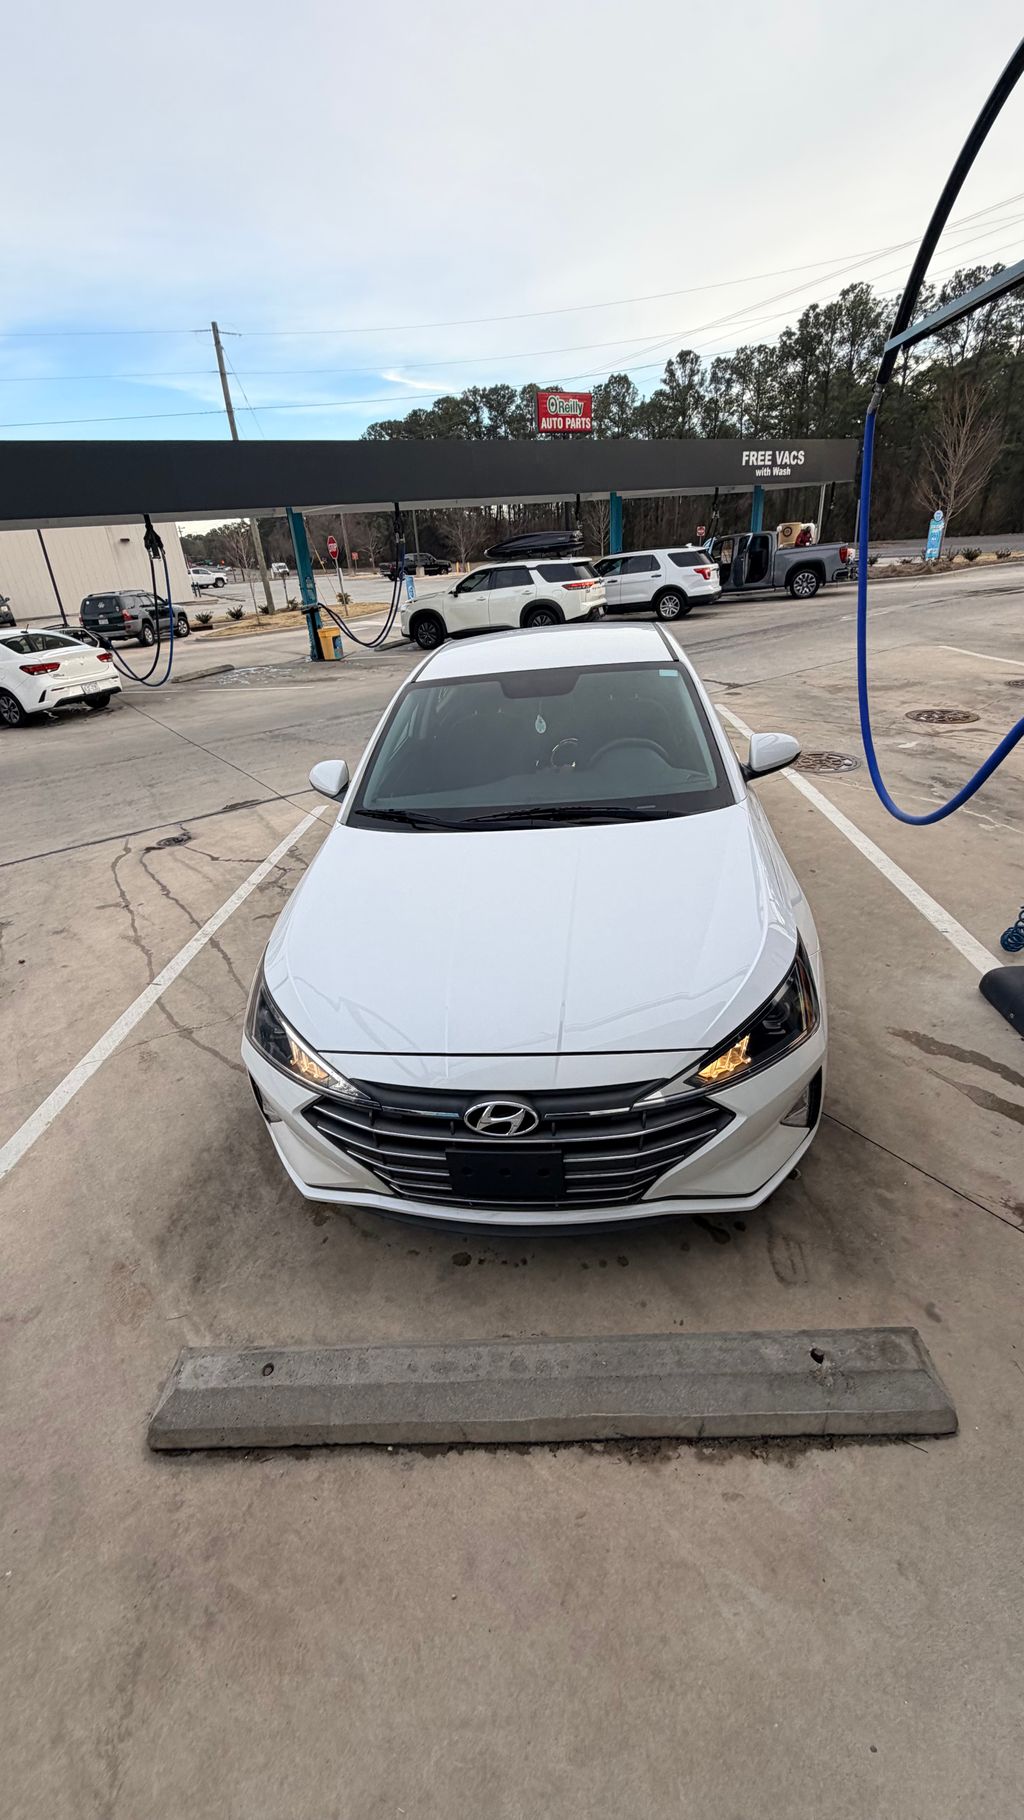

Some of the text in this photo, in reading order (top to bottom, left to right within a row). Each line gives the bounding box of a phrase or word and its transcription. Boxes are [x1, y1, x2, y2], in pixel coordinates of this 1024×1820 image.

[547, 395, 584, 416] O'Reilly
[541, 417, 591, 429] AUTO PARTS
[742, 450, 805, 466] FREE VACS
[755, 466, 791, 477] with Wash
